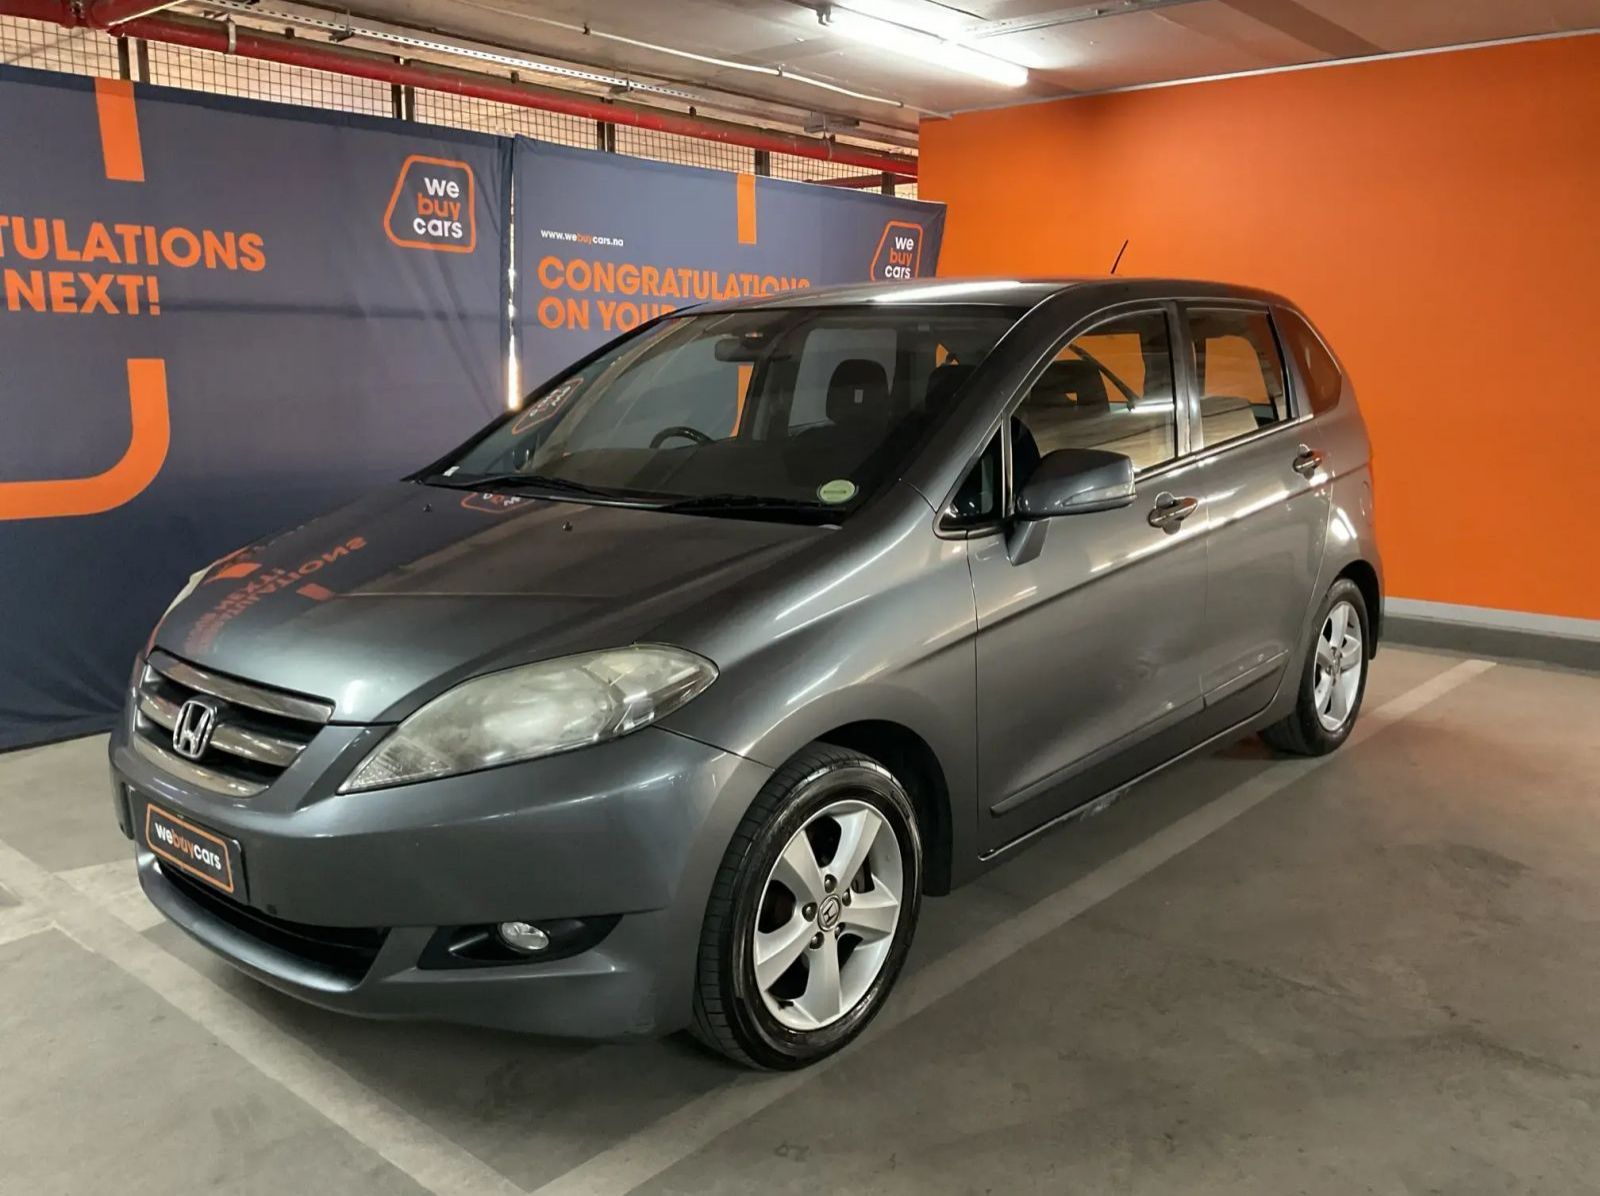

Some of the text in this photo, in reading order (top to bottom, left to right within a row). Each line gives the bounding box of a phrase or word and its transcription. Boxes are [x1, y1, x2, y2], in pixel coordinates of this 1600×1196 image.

[424, 177, 459, 198] we
[417, 192, 461, 220] buy
[413, 218, 463, 239] cars
[540, 229, 624, 247] www.webuycars.na
[895, 236, 915, 251] we
[890, 248, 913, 266] buy
[885, 265, 912, 279] cars
[4, 269, 160, 315] NEXT!
[538, 296, 590, 330] ON
[155, 822, 221, 870] webuycars
